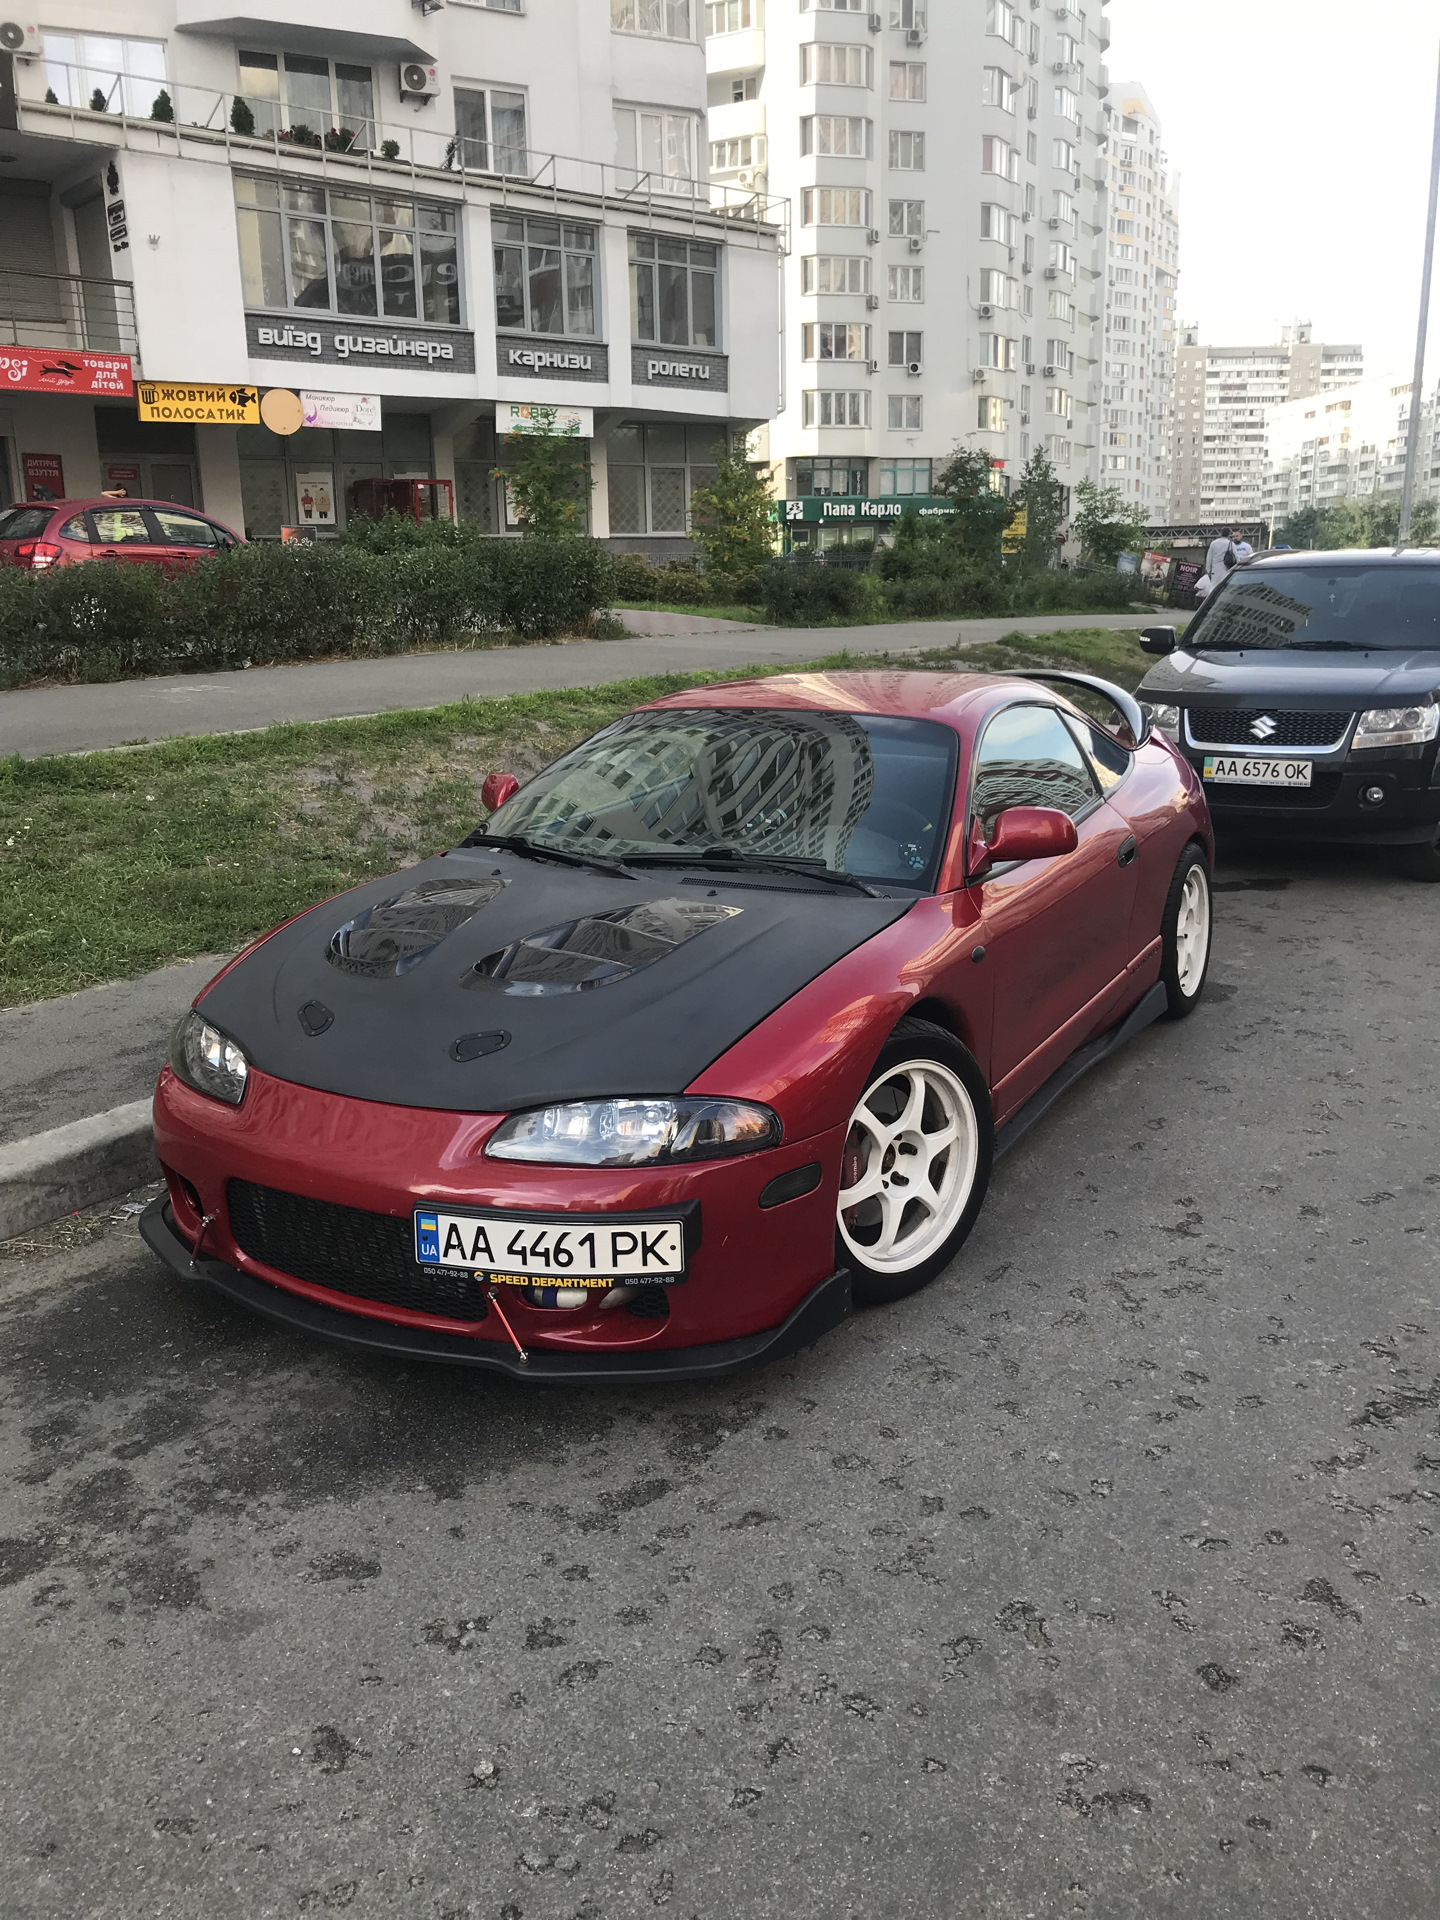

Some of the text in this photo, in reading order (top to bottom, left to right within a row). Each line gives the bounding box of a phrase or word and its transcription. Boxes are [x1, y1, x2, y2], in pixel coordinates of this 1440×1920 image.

[257, 325, 454, 364] виїзд дизайнера
[83, 359, 128, 371] товари
[508, 348, 592, 373] карнизи
[95, 370, 118, 379] для
[647, 358, 710, 380] ролети
[91, 380, 124, 390] дітей
[161, 388, 226, 403] ЖОВТИЙ
[150, 406, 246, 420] ПОЛОСАТИК
[27, 459, 59, 468] ДИТЯЧЕ
[28, 468, 59, 477] ВЗУТТЯ
[823, 502, 856, 516] Папа
[861, 501, 902, 518] Карло
[1180, 564, 1198, 574] NOIR
[1215, 760, 1309, 780] AA 6576 OK
[421, 1243, 438, 1257] UA
[442, 1222, 670, 1269] AA 4461 PK
[423, 1267, 469, 1279] 050 477-92-88
[490, 1273, 615, 1289] SPEED DEPARTMENT
[639, 1277, 675, 1285] 477-92-88
